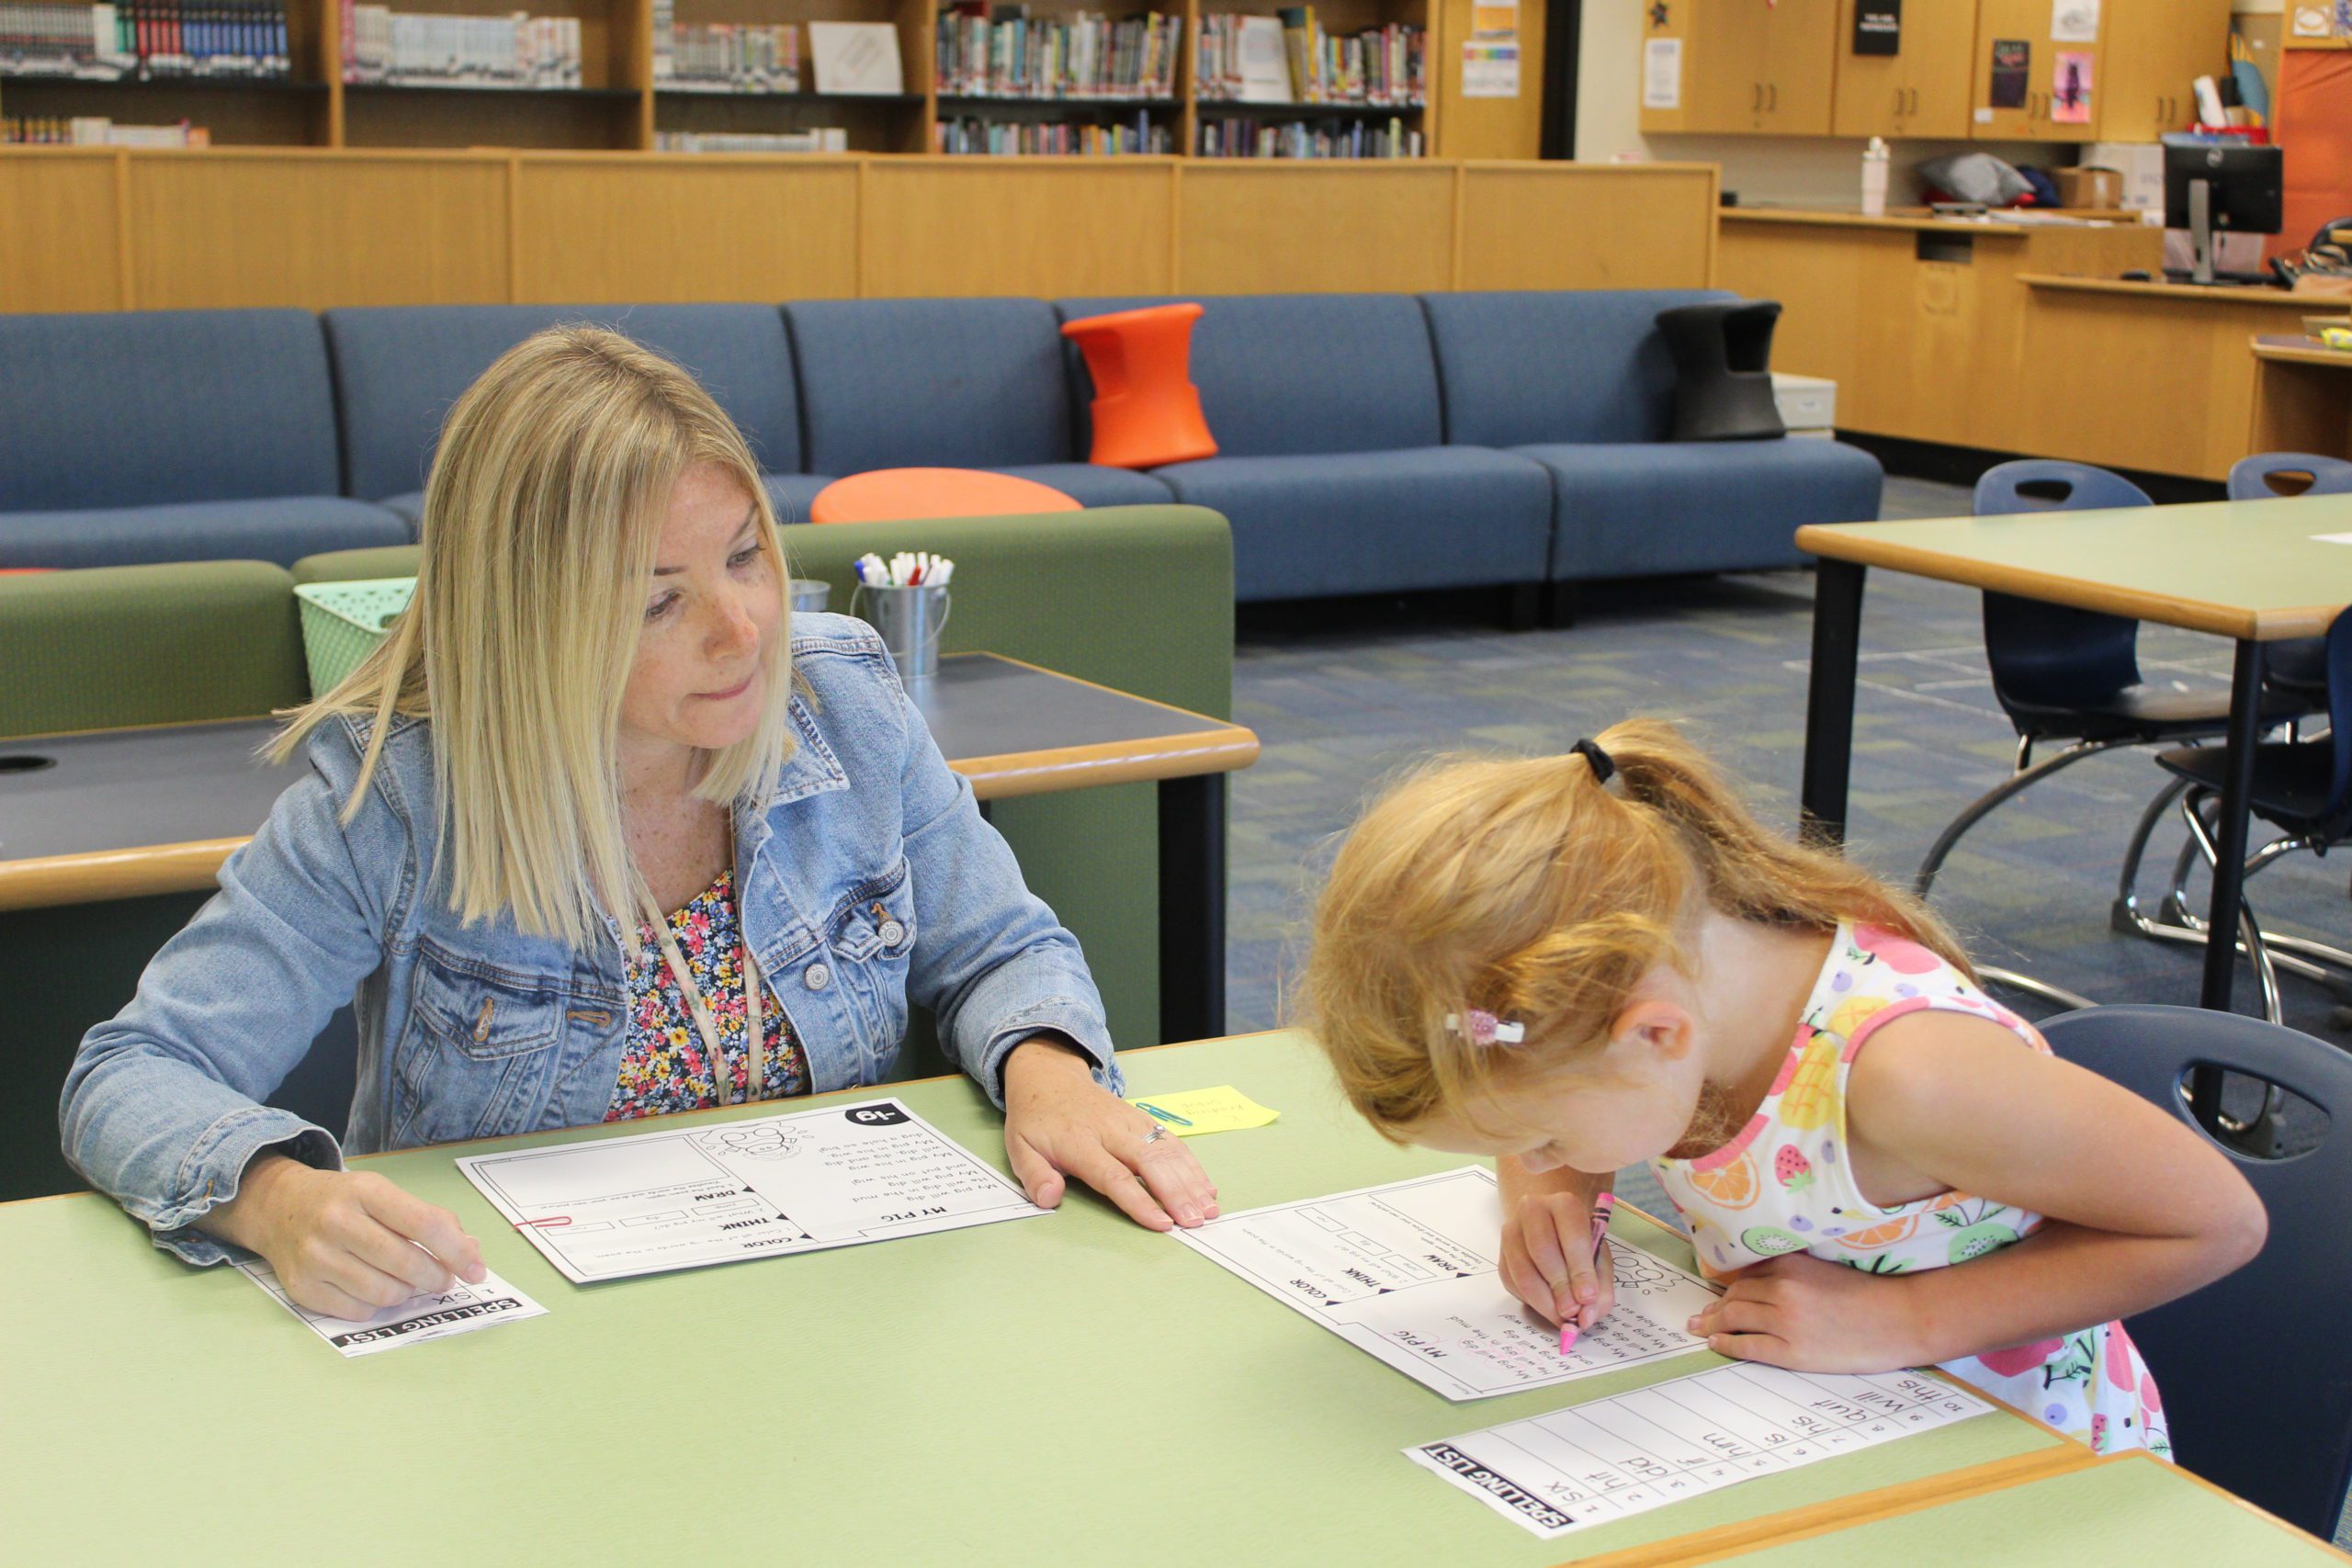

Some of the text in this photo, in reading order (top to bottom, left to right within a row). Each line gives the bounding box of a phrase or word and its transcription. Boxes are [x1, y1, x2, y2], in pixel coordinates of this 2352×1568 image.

[856, 1111, 895, 1122] -ig
[695, 1190, 736, 1201] DRAW
[881, 1207, 947, 1221] MY PIG
[719, 1218, 770, 1230] THINK
[742, 1237, 792, 1247] COLOR
[1423, 1255, 1458, 1270] DRAW
[1341, 1268, 1381, 1288] THINK
[1290, 1279, 1327, 1298] COLOR
[431, 1289, 471, 1306] six
[343, 1300, 517, 1345] SPELLING LIST
[1635, 1315, 1657, 1327] hole
[1472, 1329, 1489, 1339] the
[1632, 1328, 1653, 1337] pig
[1667, 1332, 1688, 1342] dug
[1393, 1331, 1448, 1358] MY PIG
[1498, 1314, 1593, 1365] and pt on his wig!
[1592, 1337, 1613, 1347] pig
[1650, 1339, 1668, 1348] My
[1501, 1346, 1519, 1356] dig
[1503, 1330, 1573, 1371] My pig will dig
[1611, 1348, 1629, 1358] My
[1625, 1343, 1647, 1352] will
[1475, 1350, 1496, 1359] will
[1497, 1360, 1517, 1370] pig
[1514, 1357, 1536, 1366] will
[1515, 1371, 1532, 1379] My
[1537, 1367, 1553, 1375] He
[1897, 1380, 1941, 1401] this
[1853, 1392, 1911, 1413] will
[1810, 1400, 1867, 1421] quit
[1792, 1416, 1830, 1436] his
[1702, 1433, 1751, 1458] him
[1764, 1433, 1789, 1446] is
[1618, 1457, 1668, 1477] did
[1677, 1458, 1708, 1466] if
[1425, 1446, 1566, 1528] SPELLING LIST
[1585, 1472, 1627, 1491] hit
[1544, 1481, 1584, 1502] six
